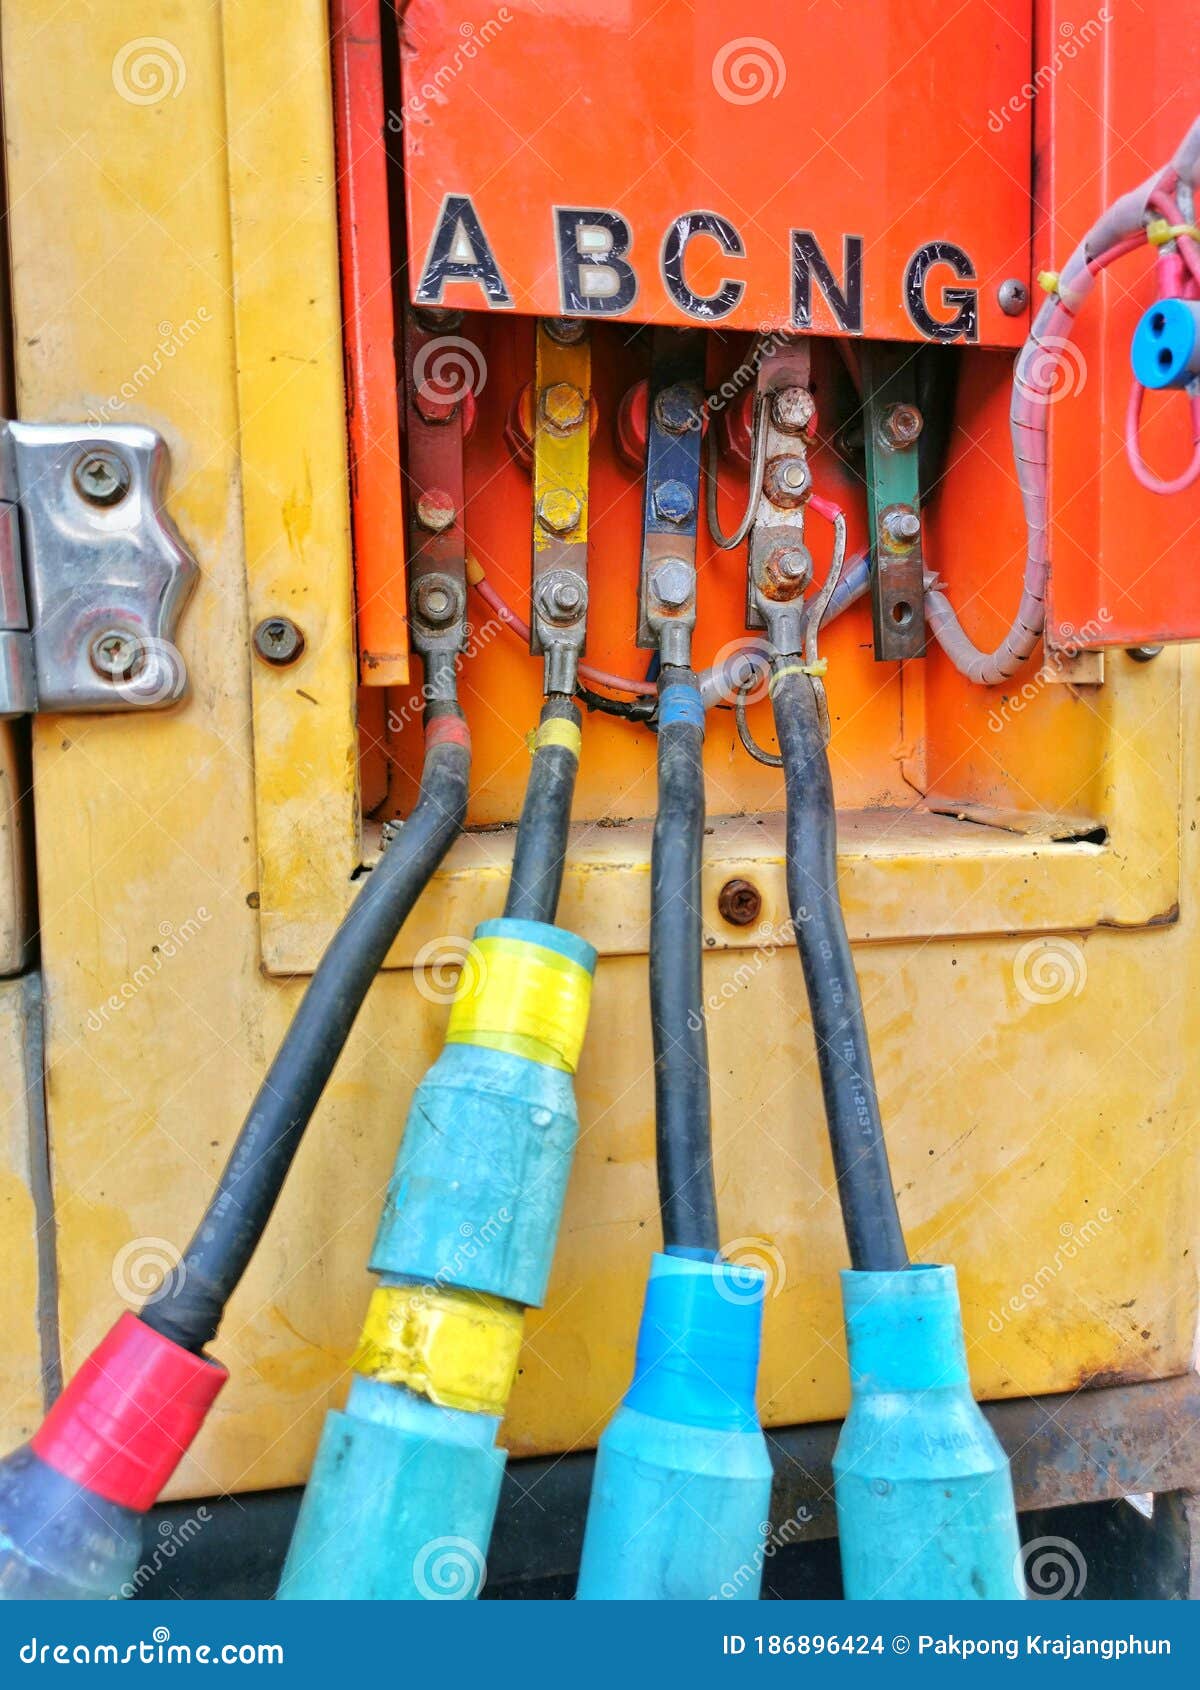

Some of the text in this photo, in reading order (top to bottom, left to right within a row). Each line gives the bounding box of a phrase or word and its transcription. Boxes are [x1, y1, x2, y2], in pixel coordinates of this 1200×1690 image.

[413, 193, 980, 345] A B C N G
[842, 1039, 856, 1062] TIS
